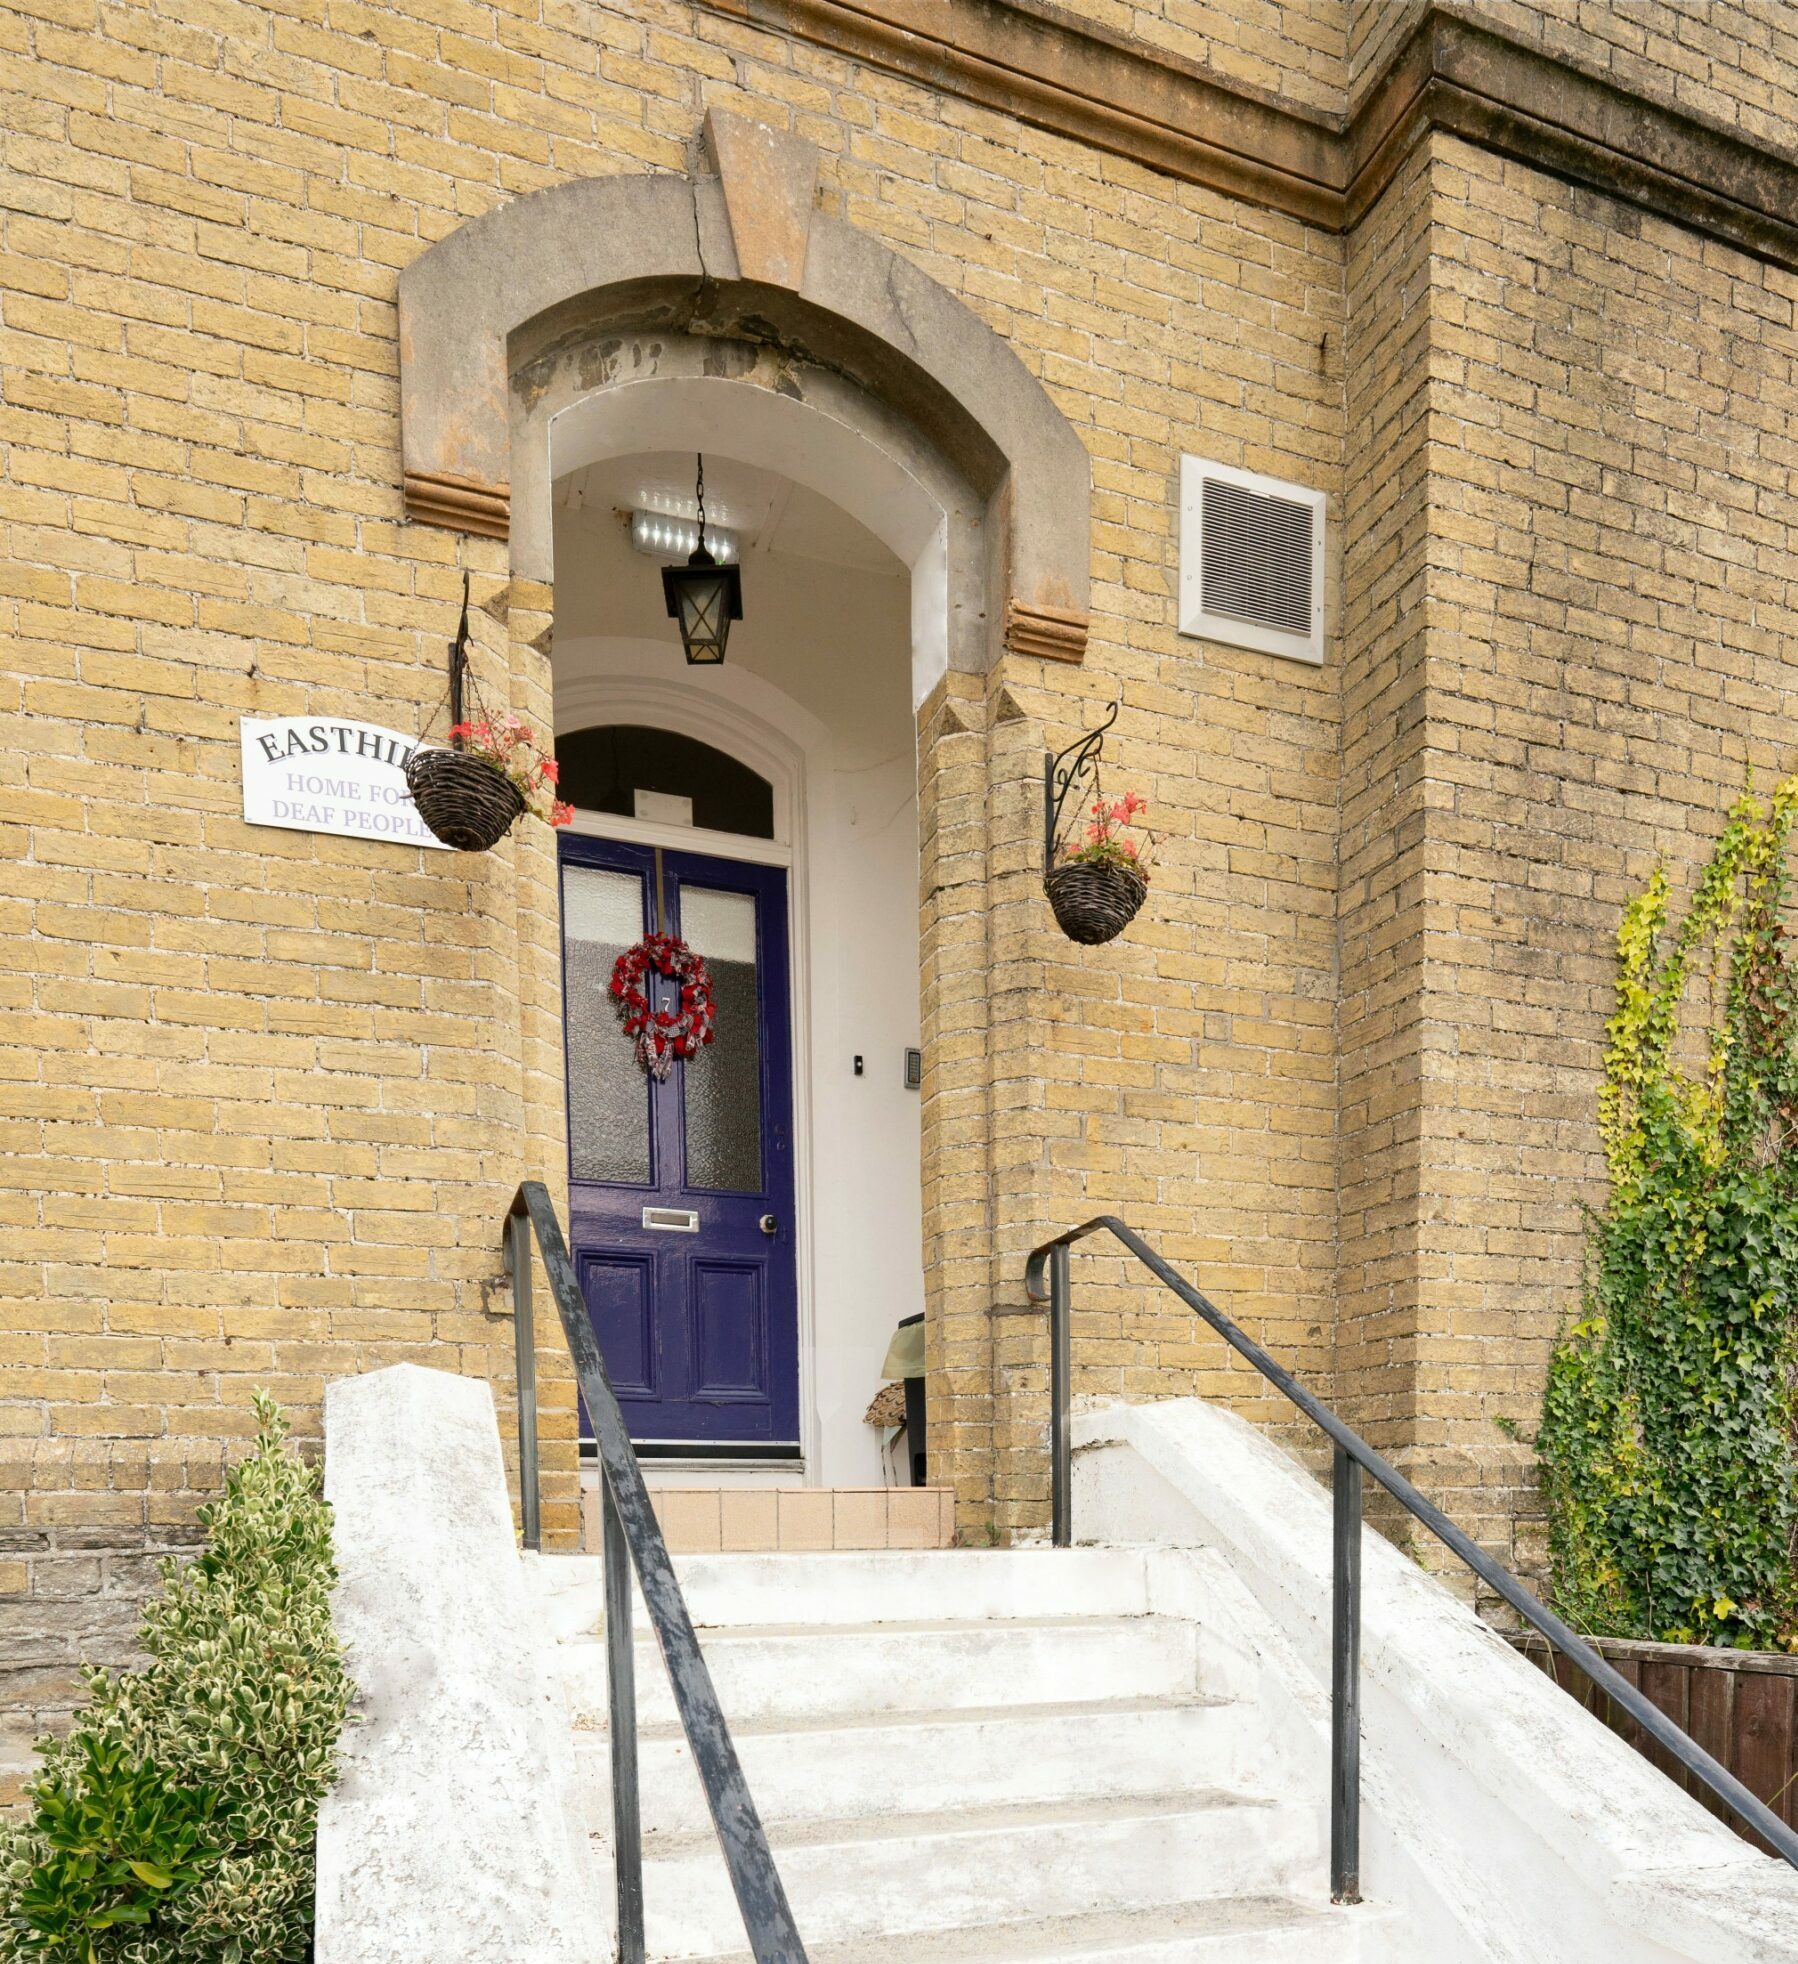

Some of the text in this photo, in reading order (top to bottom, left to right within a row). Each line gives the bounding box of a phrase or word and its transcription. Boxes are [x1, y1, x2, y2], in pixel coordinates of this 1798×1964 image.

[286, 773, 361, 800] HOME
[272, 800, 432, 838] DEAF PEOPLE
[661, 997, 670, 1012] 7
